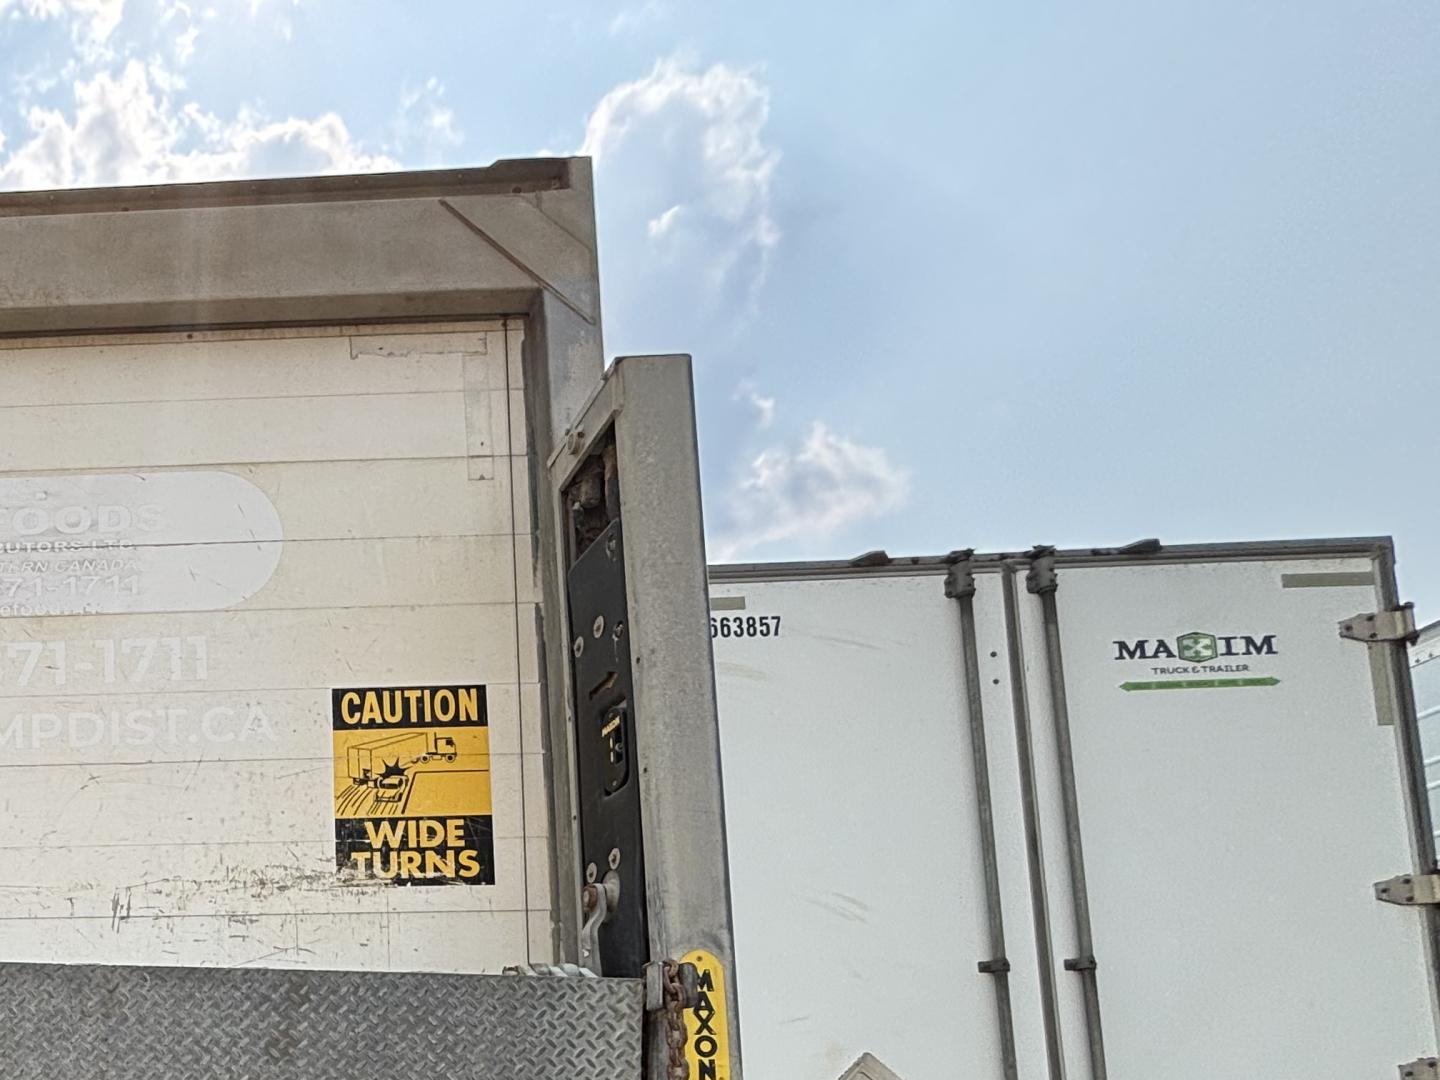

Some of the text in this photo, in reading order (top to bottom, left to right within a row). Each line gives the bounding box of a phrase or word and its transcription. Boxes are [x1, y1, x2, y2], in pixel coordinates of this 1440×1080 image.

[55, 558, 137, 574] CANADA
[1112, 631, 1279, 664] MAXIM
[1151, 666, 1190, 676] TRUCK
[1200, 664, 1250, 675] TRAILER
[341, 687, 479, 725] CAUTION
[363, 818, 466, 850] WIDE
[350, 849, 481, 880] TURNS
